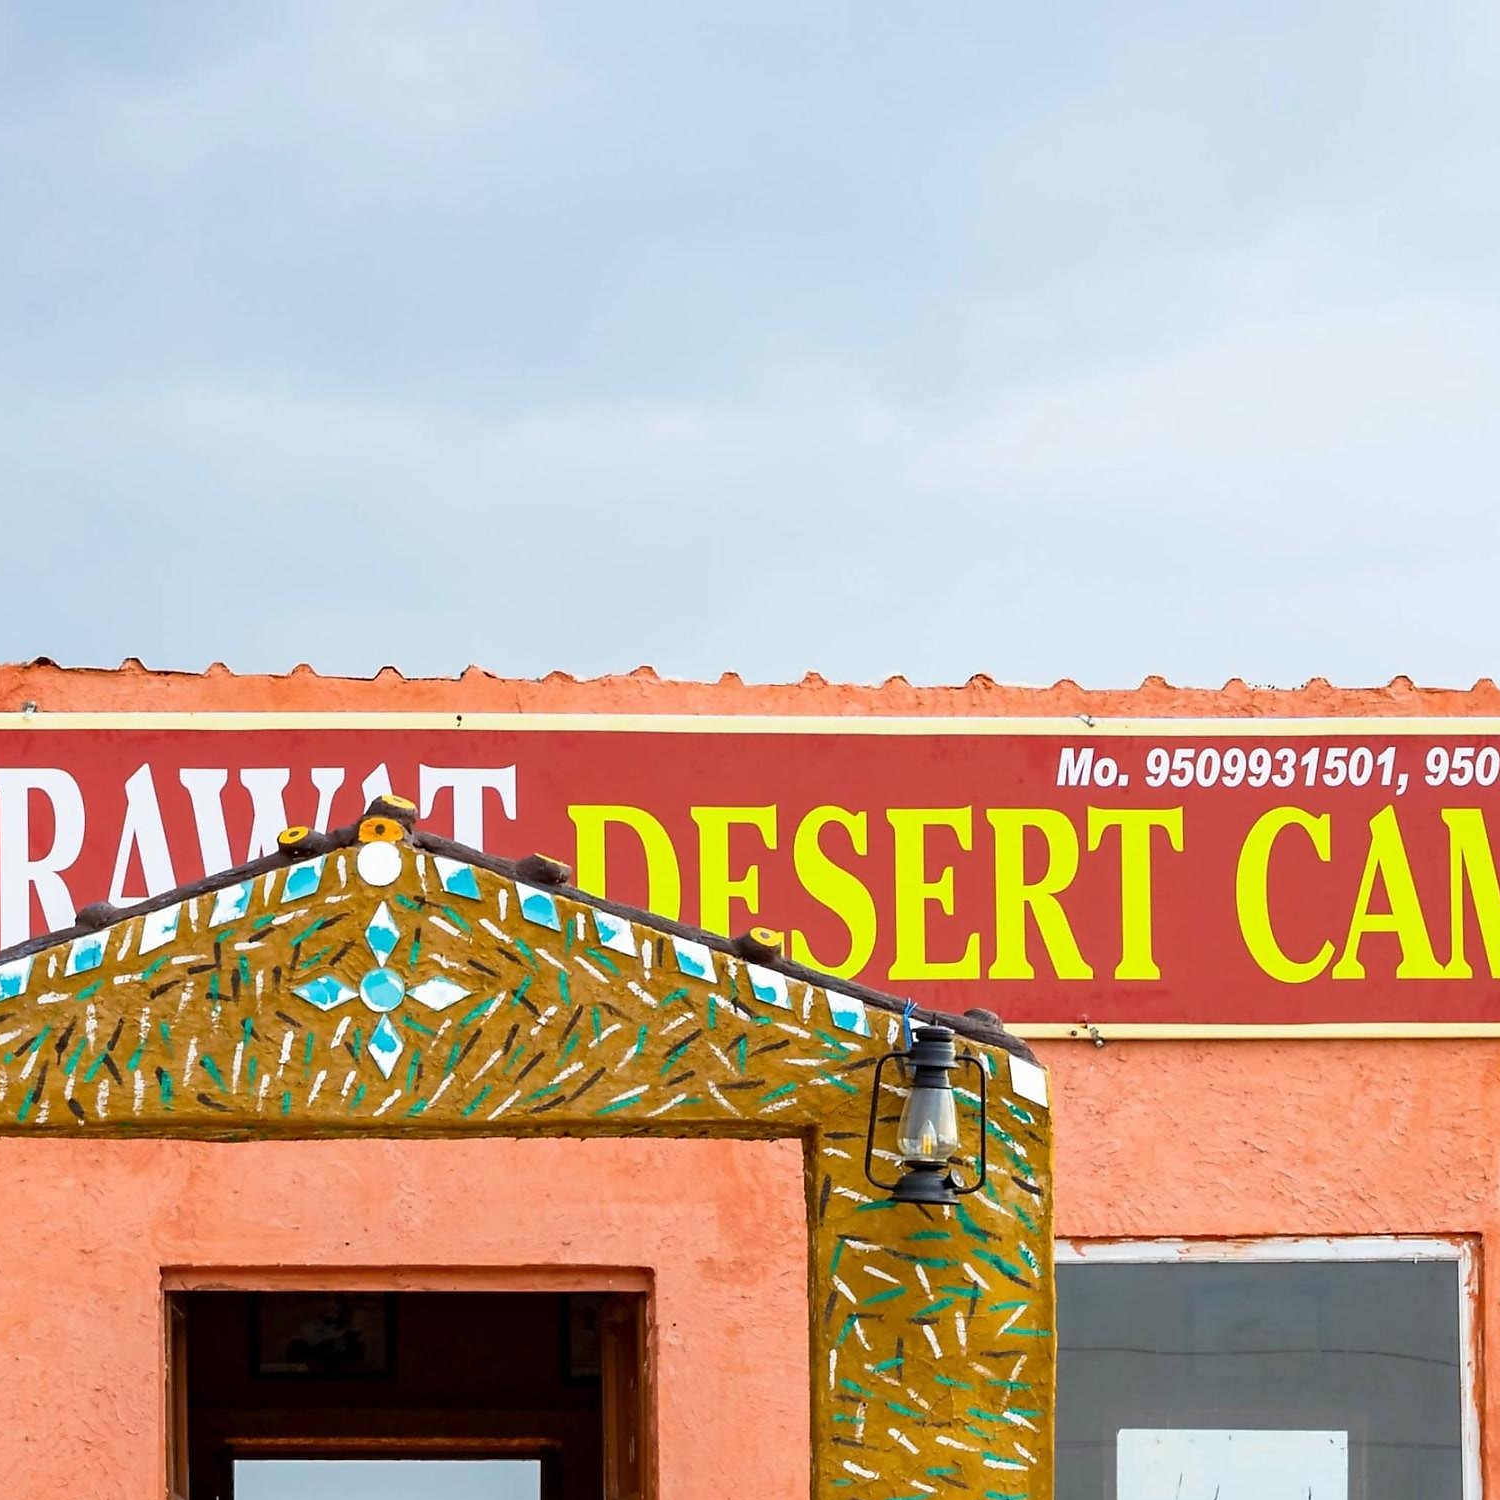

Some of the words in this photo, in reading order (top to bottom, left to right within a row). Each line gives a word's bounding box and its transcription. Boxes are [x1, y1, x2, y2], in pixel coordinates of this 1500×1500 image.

[1056, 747, 1129, 787] Mo.
[1145, 746, 1410, 796] 9509931501,
[567, 804, 1185, 981] DESERT
